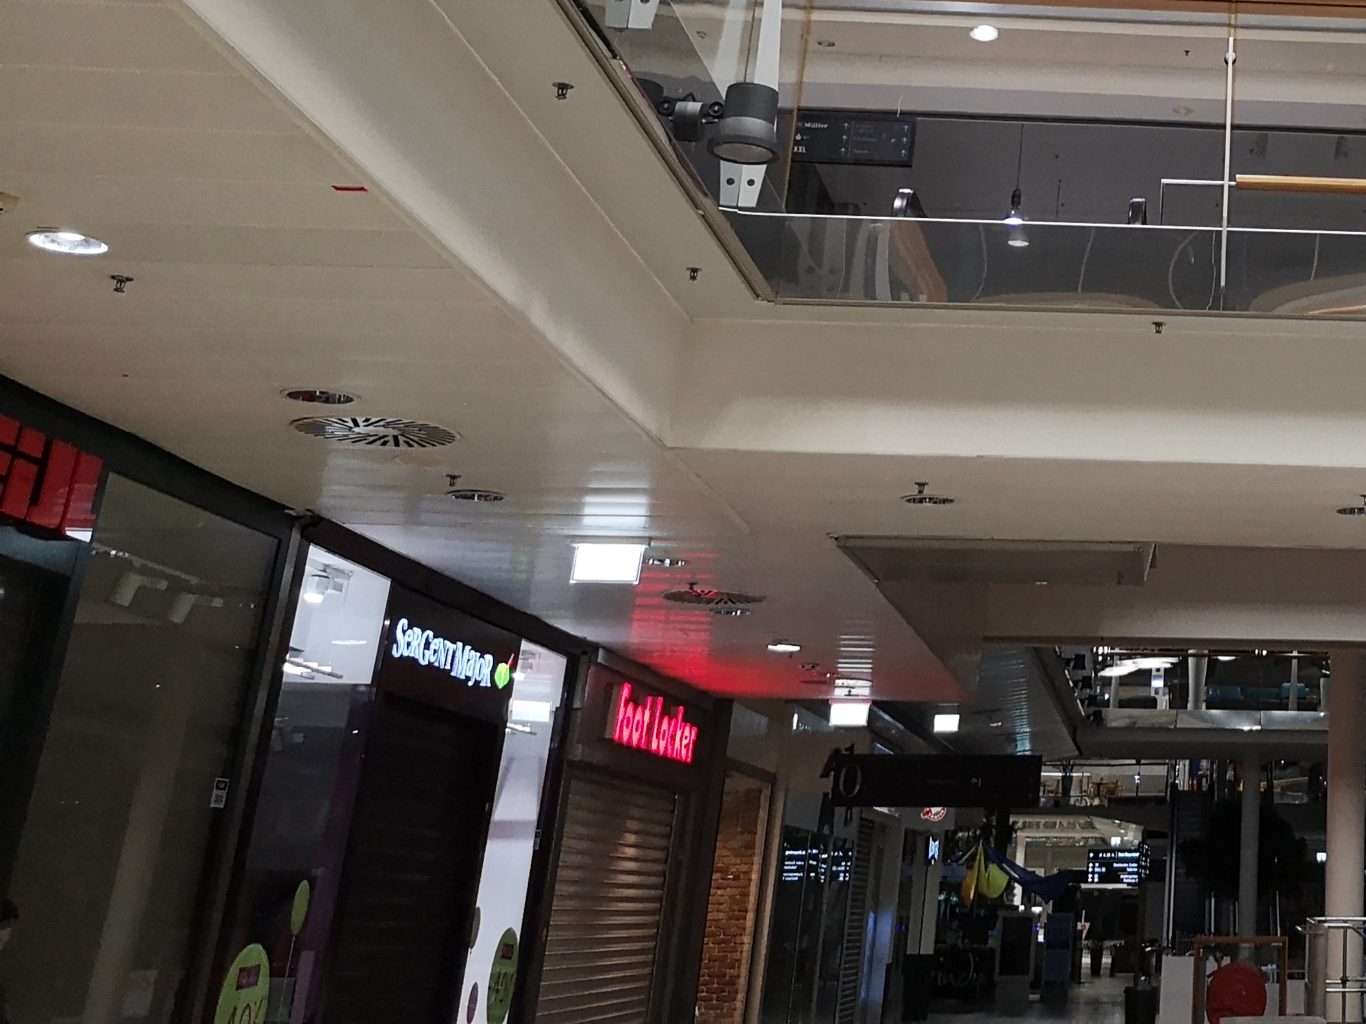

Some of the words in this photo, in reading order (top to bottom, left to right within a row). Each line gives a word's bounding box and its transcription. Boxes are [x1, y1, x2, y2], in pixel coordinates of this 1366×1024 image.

[613, 682, 652, 749] Foot
[651, 696, 698, 763] Locker
[839, 764, 863, 798] 0
